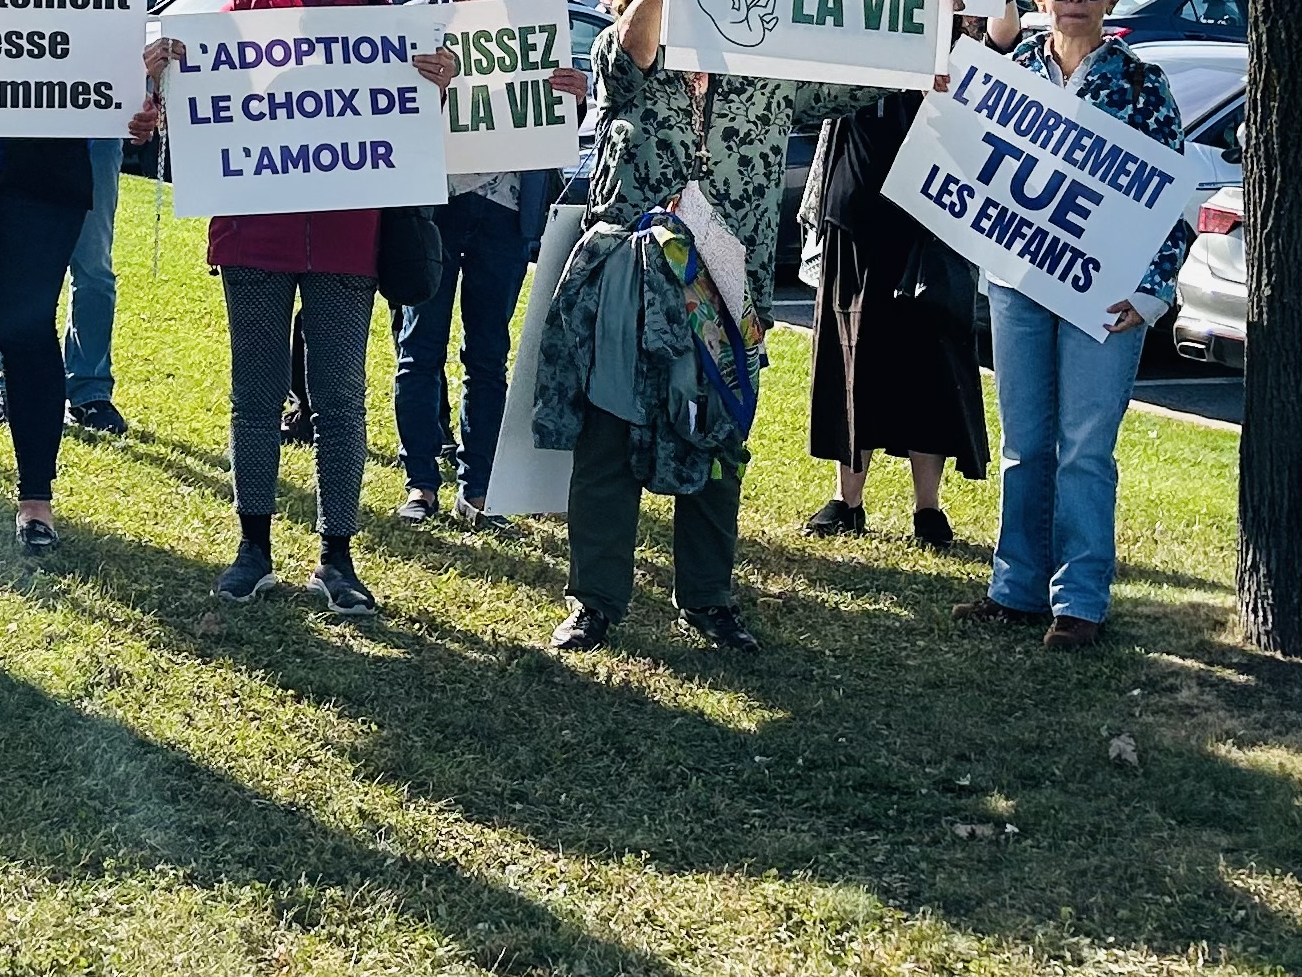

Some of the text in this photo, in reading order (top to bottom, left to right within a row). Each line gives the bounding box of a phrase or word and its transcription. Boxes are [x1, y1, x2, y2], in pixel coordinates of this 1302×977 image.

[188, 86, 420, 125] LE CHOIX DE
[448, 78, 565, 133] LA VIE
[952, 65, 1175, 210] L'AVORTEMENT
[221, 140, 396, 178] L'AMOUR
[976, 131, 1105, 240] TUE
[920, 163, 1102, 294] LES ENFANTS
